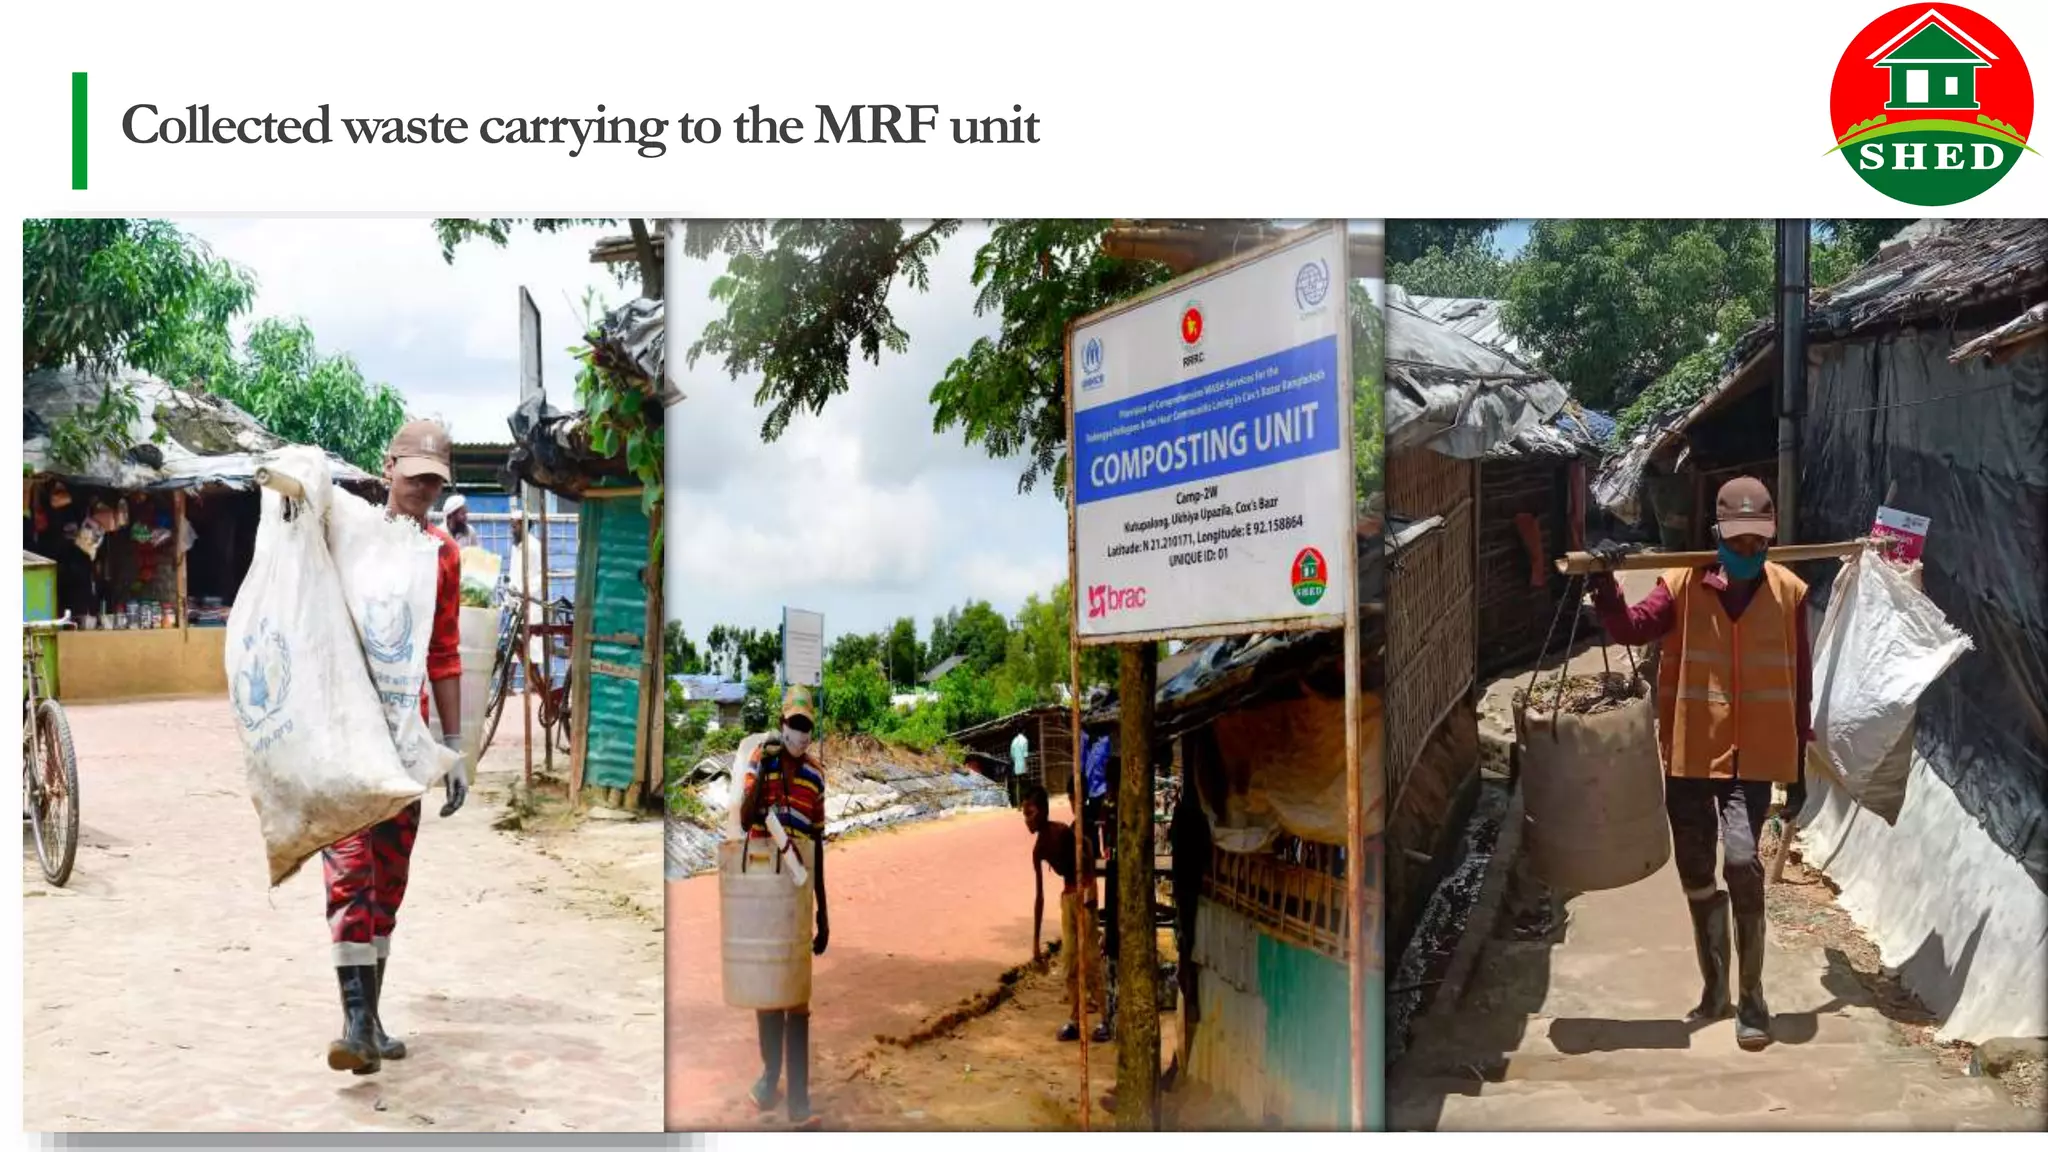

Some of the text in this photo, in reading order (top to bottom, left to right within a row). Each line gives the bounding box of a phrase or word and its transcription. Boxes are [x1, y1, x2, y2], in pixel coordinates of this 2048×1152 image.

[1183, 352, 1205, 367] RRRC
[1226, 374, 1254, 389] Services
[1255, 369, 1266, 381] for
[1267, 365, 1279, 377] the
[1090, 401, 1319, 488] COMPOSTING UNIT
[1176, 485, 1218, 505] Camp-2W
[1171, 511, 1199, 525] Ukhiya
[1200, 504, 1234, 521] Upazila,
[1235, 500, 1257, 514] Cox's
[1107, 514, 1303, 558] Latitude: N 21.210171, Longitude: E 92.158864
[1169, 547, 1228, 567] UNIQUE ID: 01
[1108, 584, 1146, 610] brac
[1295, 586, 1323, 598] SHED
